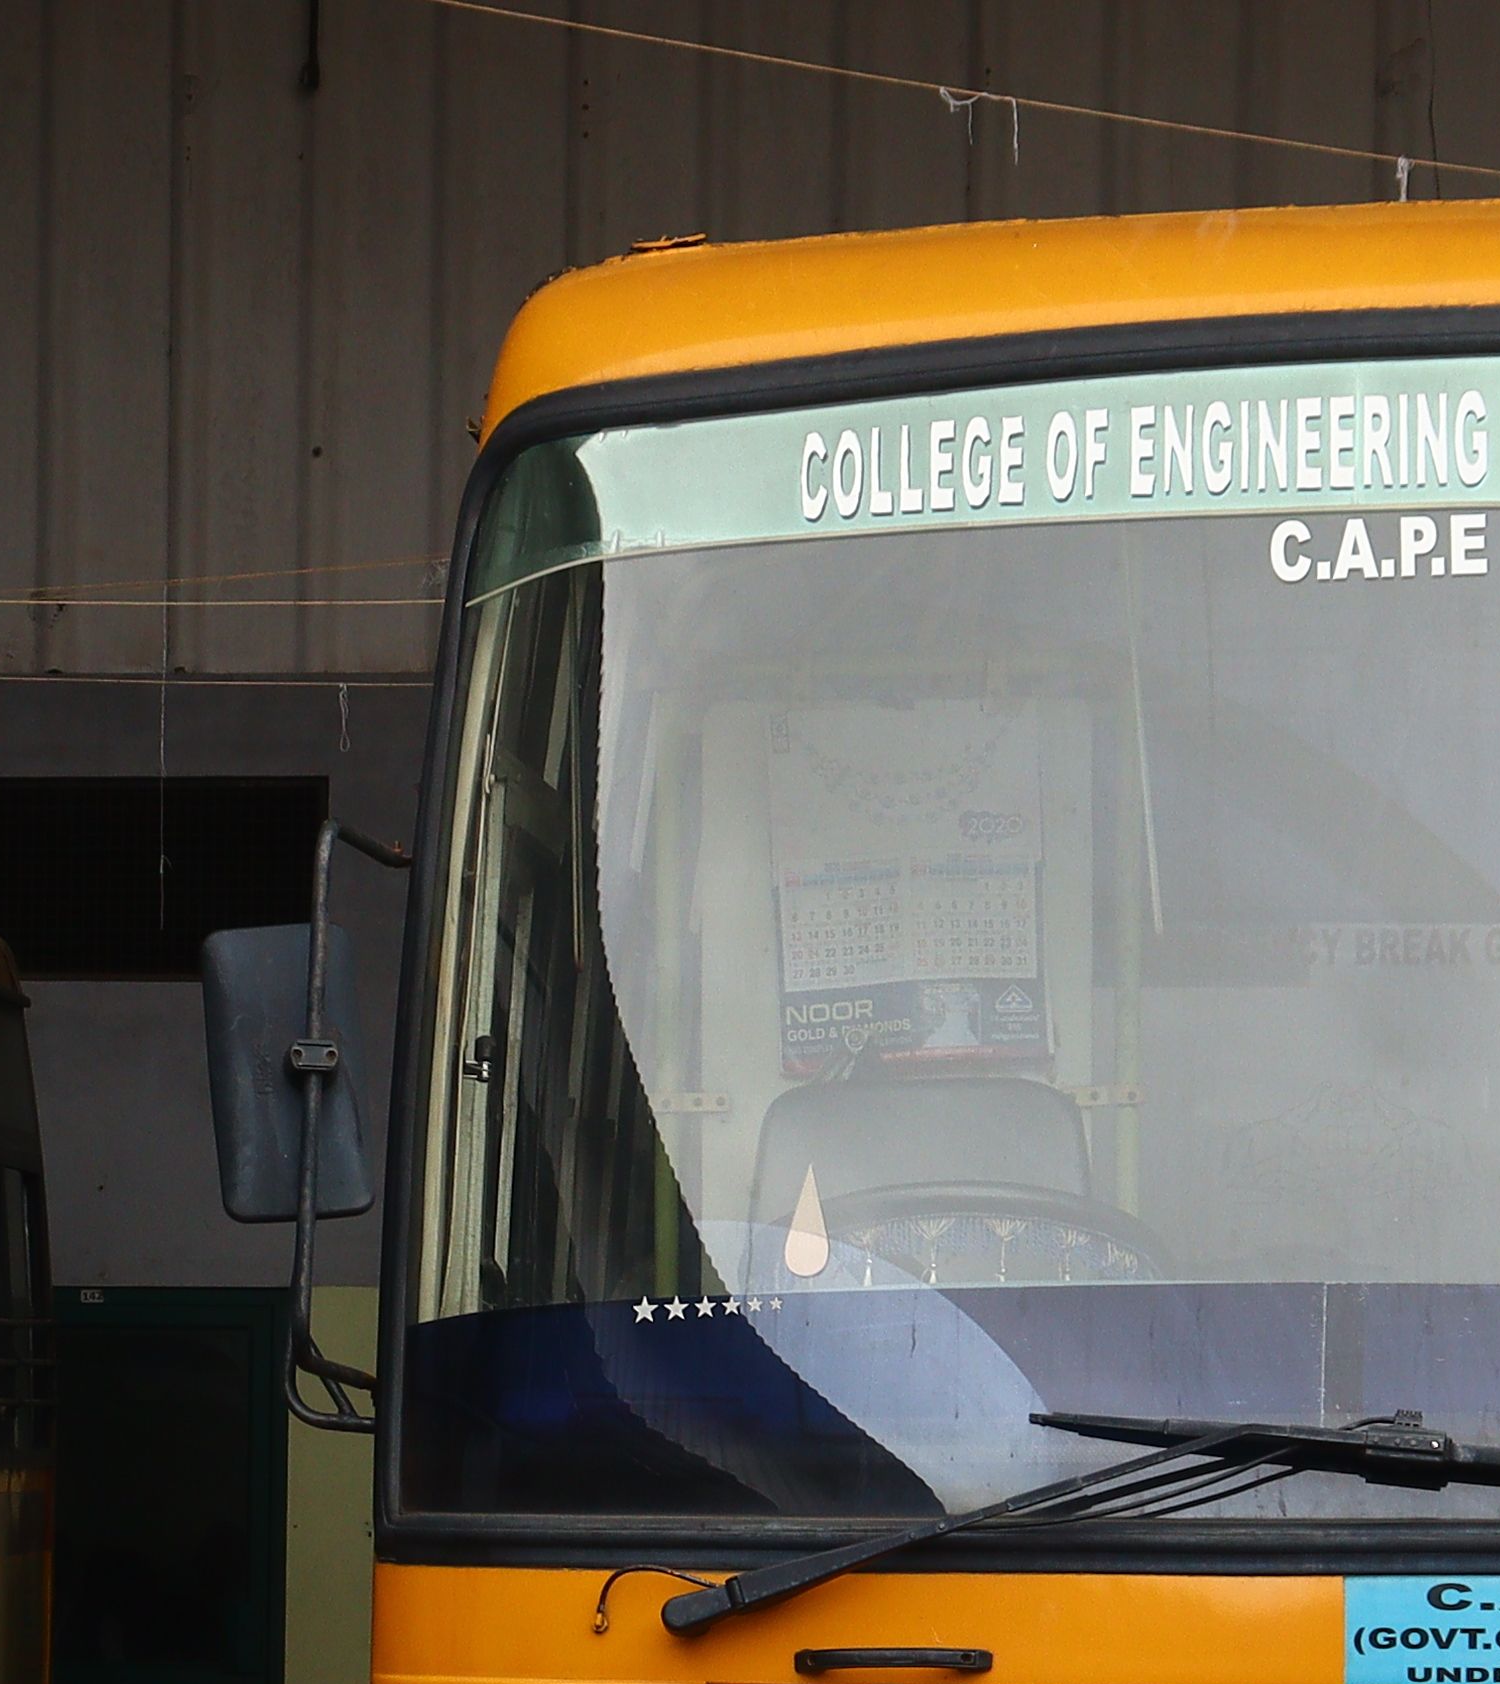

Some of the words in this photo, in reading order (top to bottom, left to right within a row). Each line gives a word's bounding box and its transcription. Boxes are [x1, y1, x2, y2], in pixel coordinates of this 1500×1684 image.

[800, 415, 1026, 522] COLLEGE
[1045, 407, 1110, 502] OF
[1130, 390, 1489, 498] ENGINEERING
[1269, 514, 1489, 582] C.A.P.E
[968, 817, 1022, 834] 2020
[1354, 928, 1472, 966] BREAK
[786, 1000, 873, 1025] NOOR
[787, 1028, 825, 1042] GOLD
[829, 1027, 838, 1038] &
